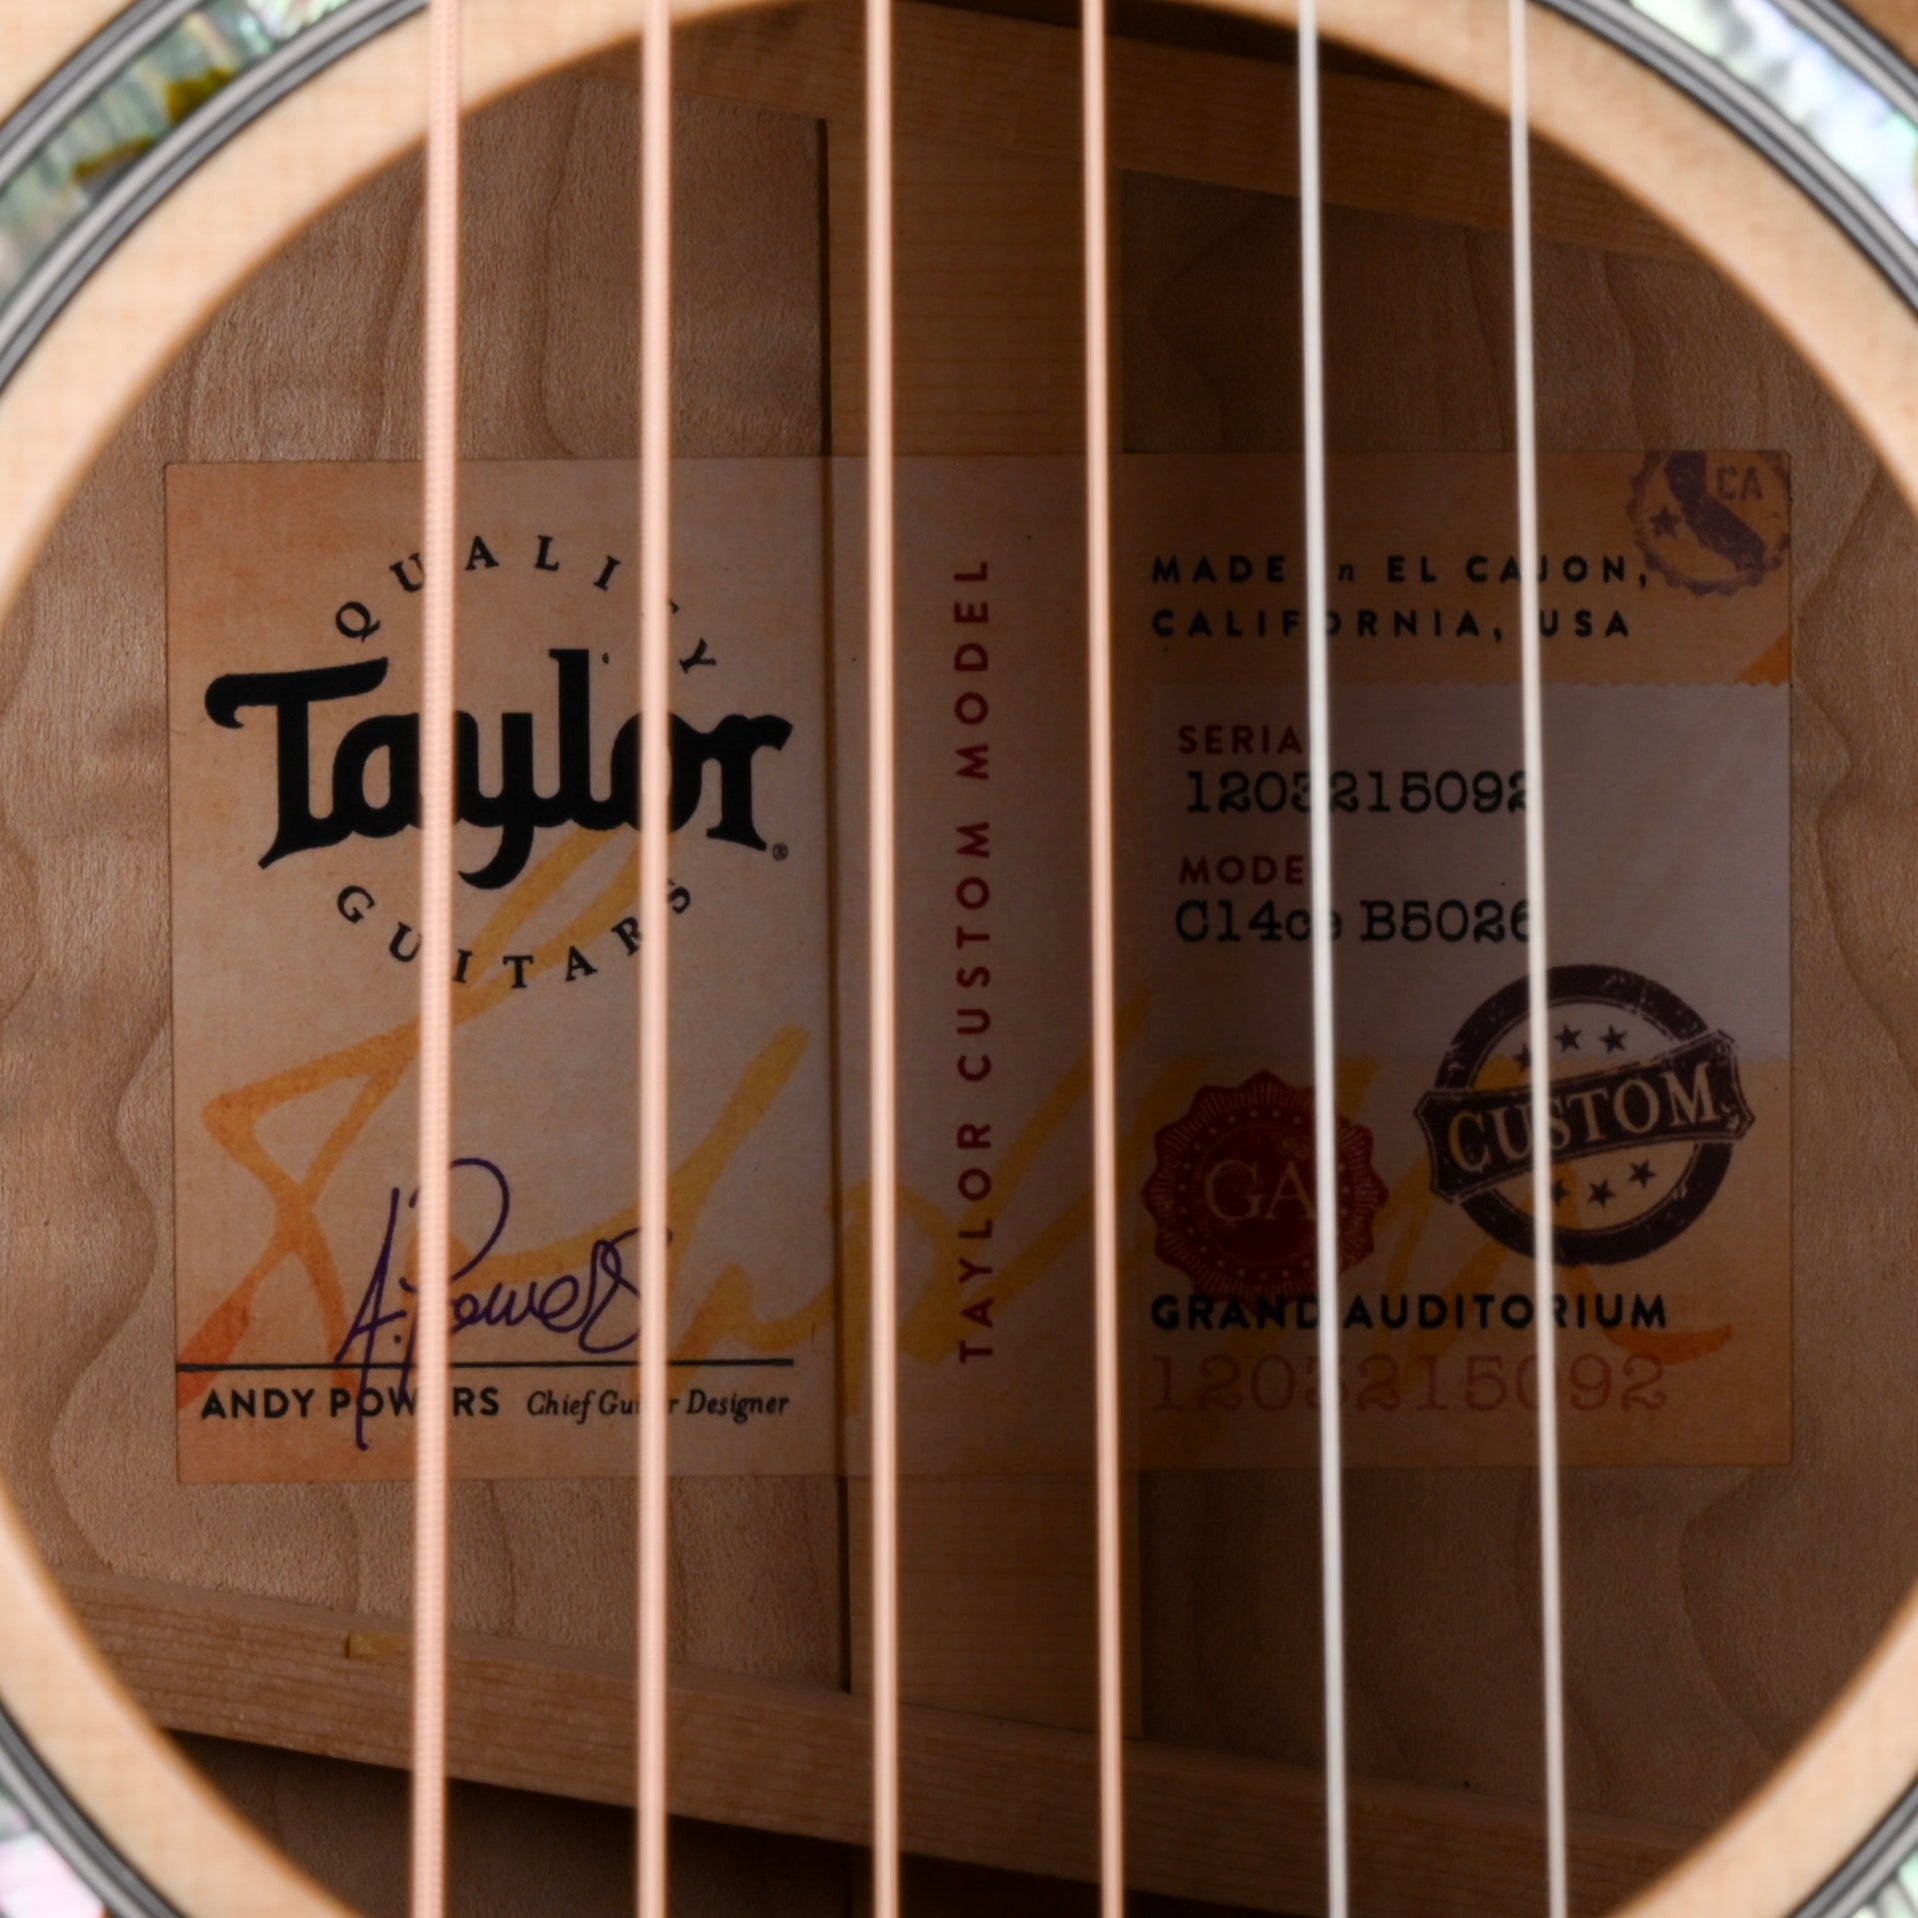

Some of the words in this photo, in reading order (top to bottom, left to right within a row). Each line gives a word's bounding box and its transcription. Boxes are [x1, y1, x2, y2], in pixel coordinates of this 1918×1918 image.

[1716, 465, 1763, 500] CA
[1152, 555, 1286, 584] MADE
[1387, 555, 1438, 583] EL
[1467, 554, 1647, 588] CAJON,
[335, 535, 717, 674] QUALIY
[1152, 609, 1502, 641] CALIFORNIA,
[1537, 609, 1629, 637] USA
[953, 560, 990, 781] MODEL
[204, 648, 793, 890] Taylor
[1178, 724, 1304, 755] SERIA
[1178, 855, 1305, 885] MODE
[337, 878, 691, 989] GUITARS
[955, 821, 992, 1083] CUSTOM
[1448, 1061, 1724, 1174] CUSTOM
[1204, 1158, 1318, 1221] GA
[957, 1122, 994, 1364] TAYLOR
[1151, 1293, 1319, 1330] GRAND
[1343, 1293, 1667, 1330] AUDITORIUM
[200, 1387, 316, 1419] ANDY
[329, 1386, 500, 1418] POWRS
[527, 1387, 597, 1425] Chief
[686, 1387, 790, 1423] Designer
